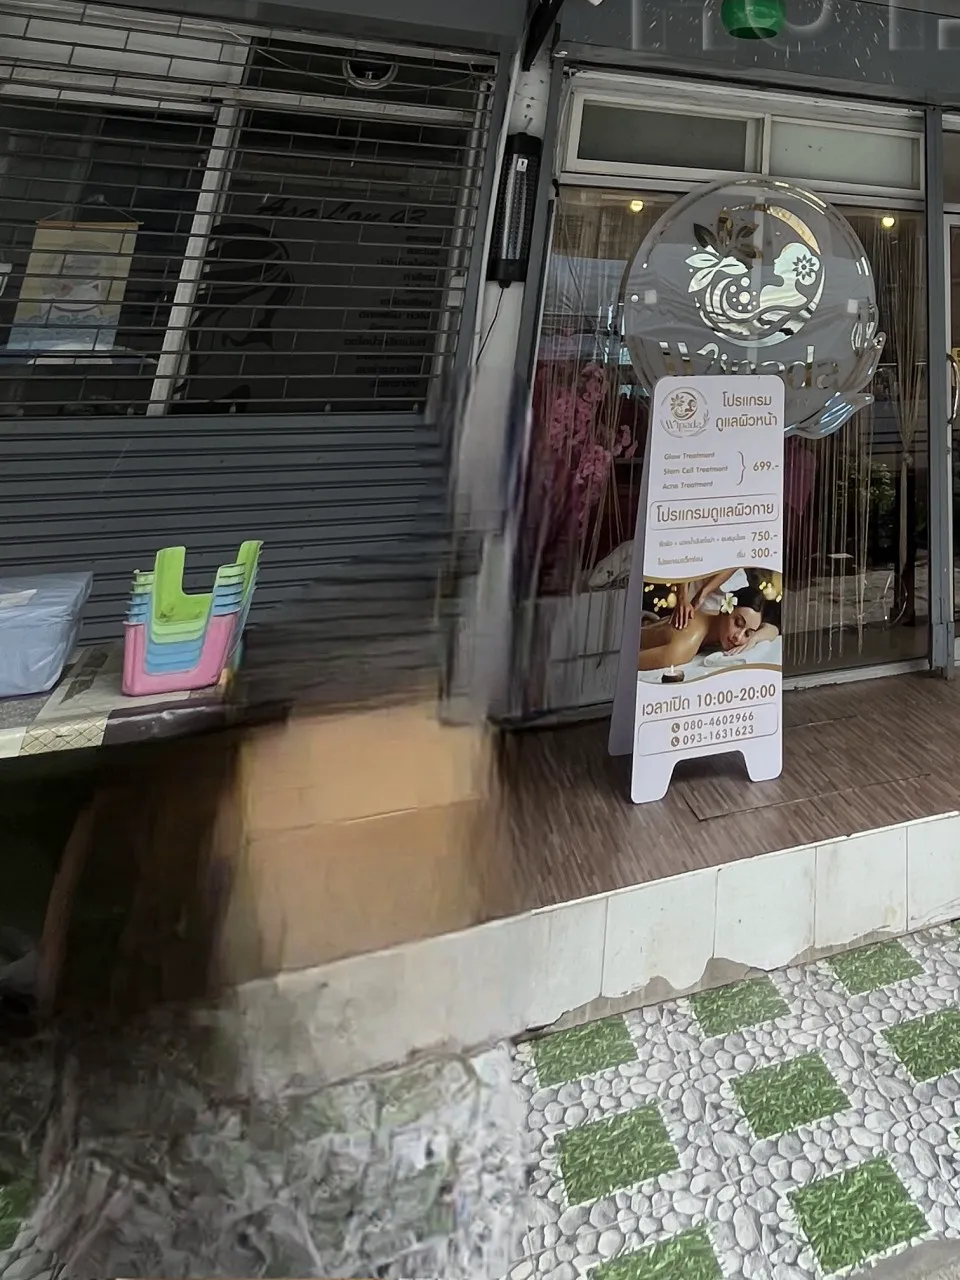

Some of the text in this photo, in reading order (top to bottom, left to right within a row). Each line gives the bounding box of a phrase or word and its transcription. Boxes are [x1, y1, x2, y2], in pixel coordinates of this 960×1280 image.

[722, 391, 772, 407] โปรแกรม
[715, 412, 778, 432] ดูแลผิวหน้า
[753, 461, 779, 472] 699.-
[656, 503, 774, 523] โปรแกรมดูแลผิวกาย
[751, 530, 778, 542] 750.-
[751, 547, 778, 559] 300.-
[642, 683, 776, 717] เวลาเปิด 10:00-20:00
[683, 711, 754, 731] 080-4602966
[683, 725, 754, 745] 093-1631623
